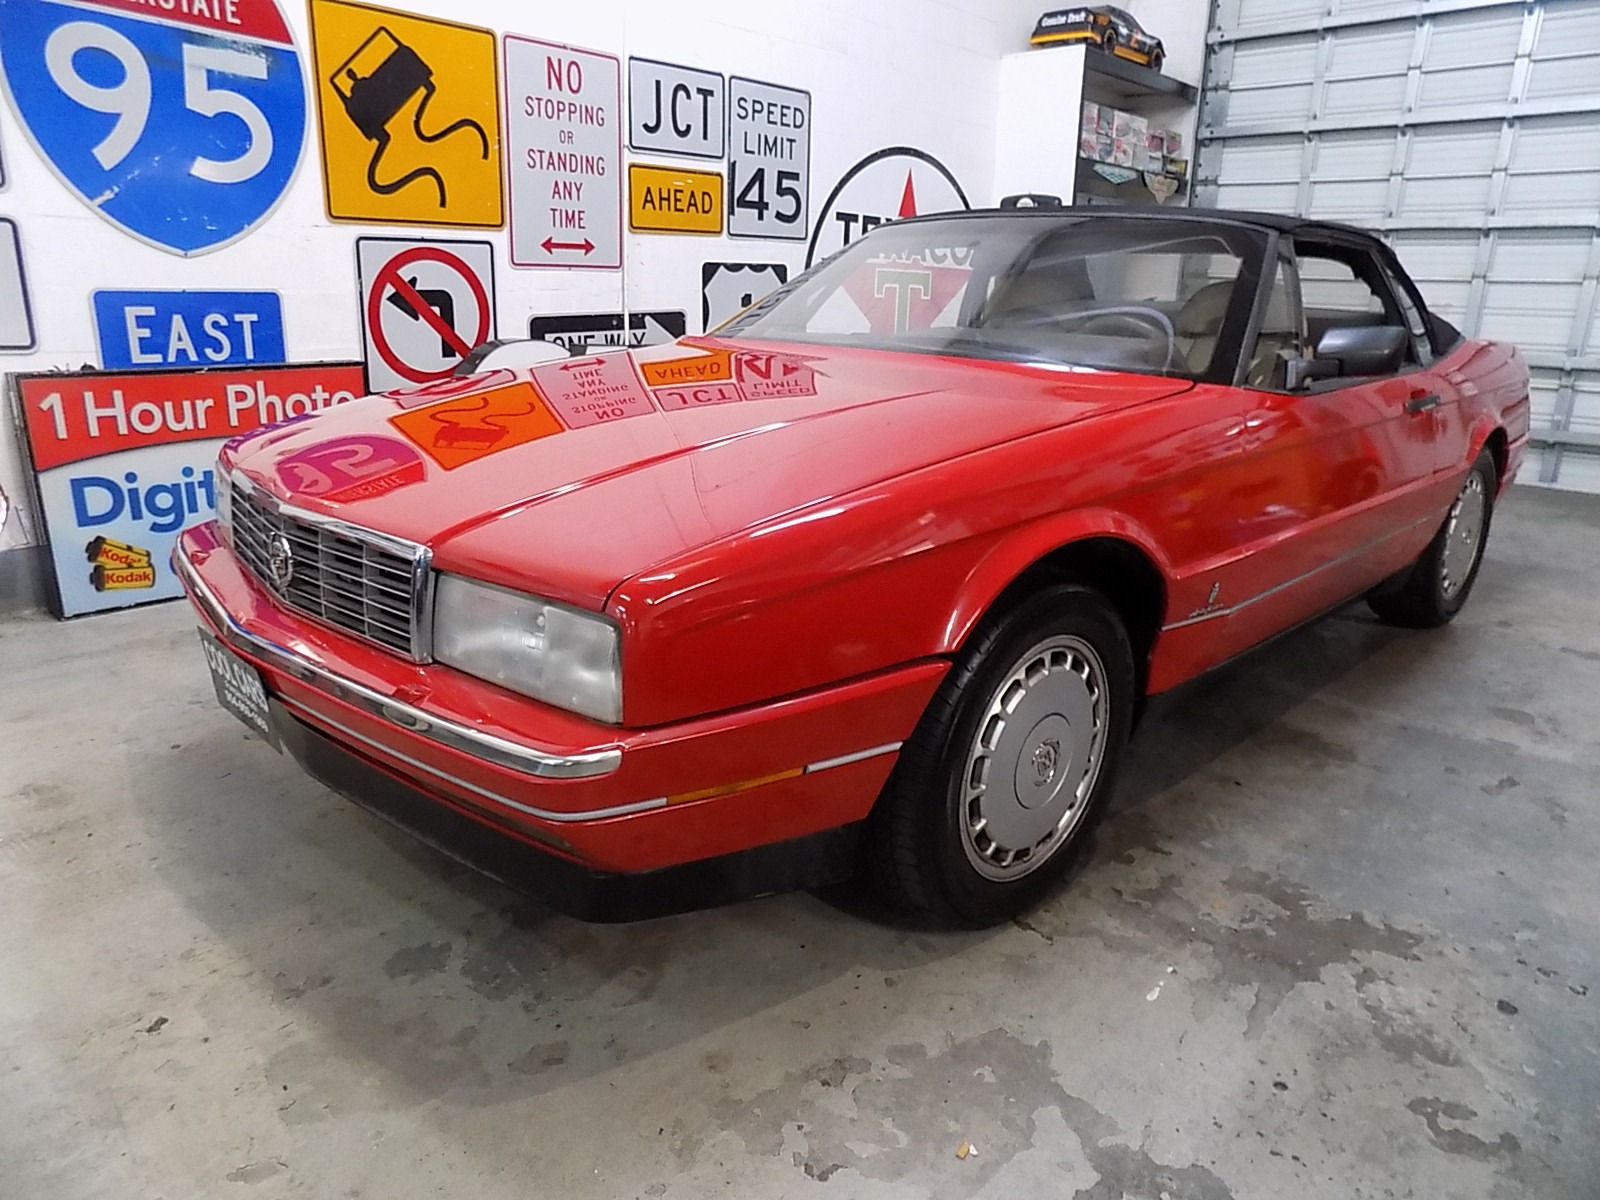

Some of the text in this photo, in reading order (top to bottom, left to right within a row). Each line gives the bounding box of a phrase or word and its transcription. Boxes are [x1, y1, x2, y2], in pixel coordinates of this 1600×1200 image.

[546, 56, 583, 94] NO
[45, 21, 273, 184] 95
[524, 95, 606, 127] STOPPING
[641, 79, 715, 141] JCT
[736, 97, 805, 129] SPEED
[559, 130, 574, 145] OR
[743, 131, 797, 160] LIMIT
[526, 149, 606, 177] STANDING
[551, 180, 584, 202] ANY
[641, 186, 714, 215] AHEAD
[549, 208, 586, 230] TIME
[124, 304, 260, 365] EAST
[38, 393, 68, 440] 1
[84, 389, 214, 437] Hour
[105, 571, 152, 584] Kodak
